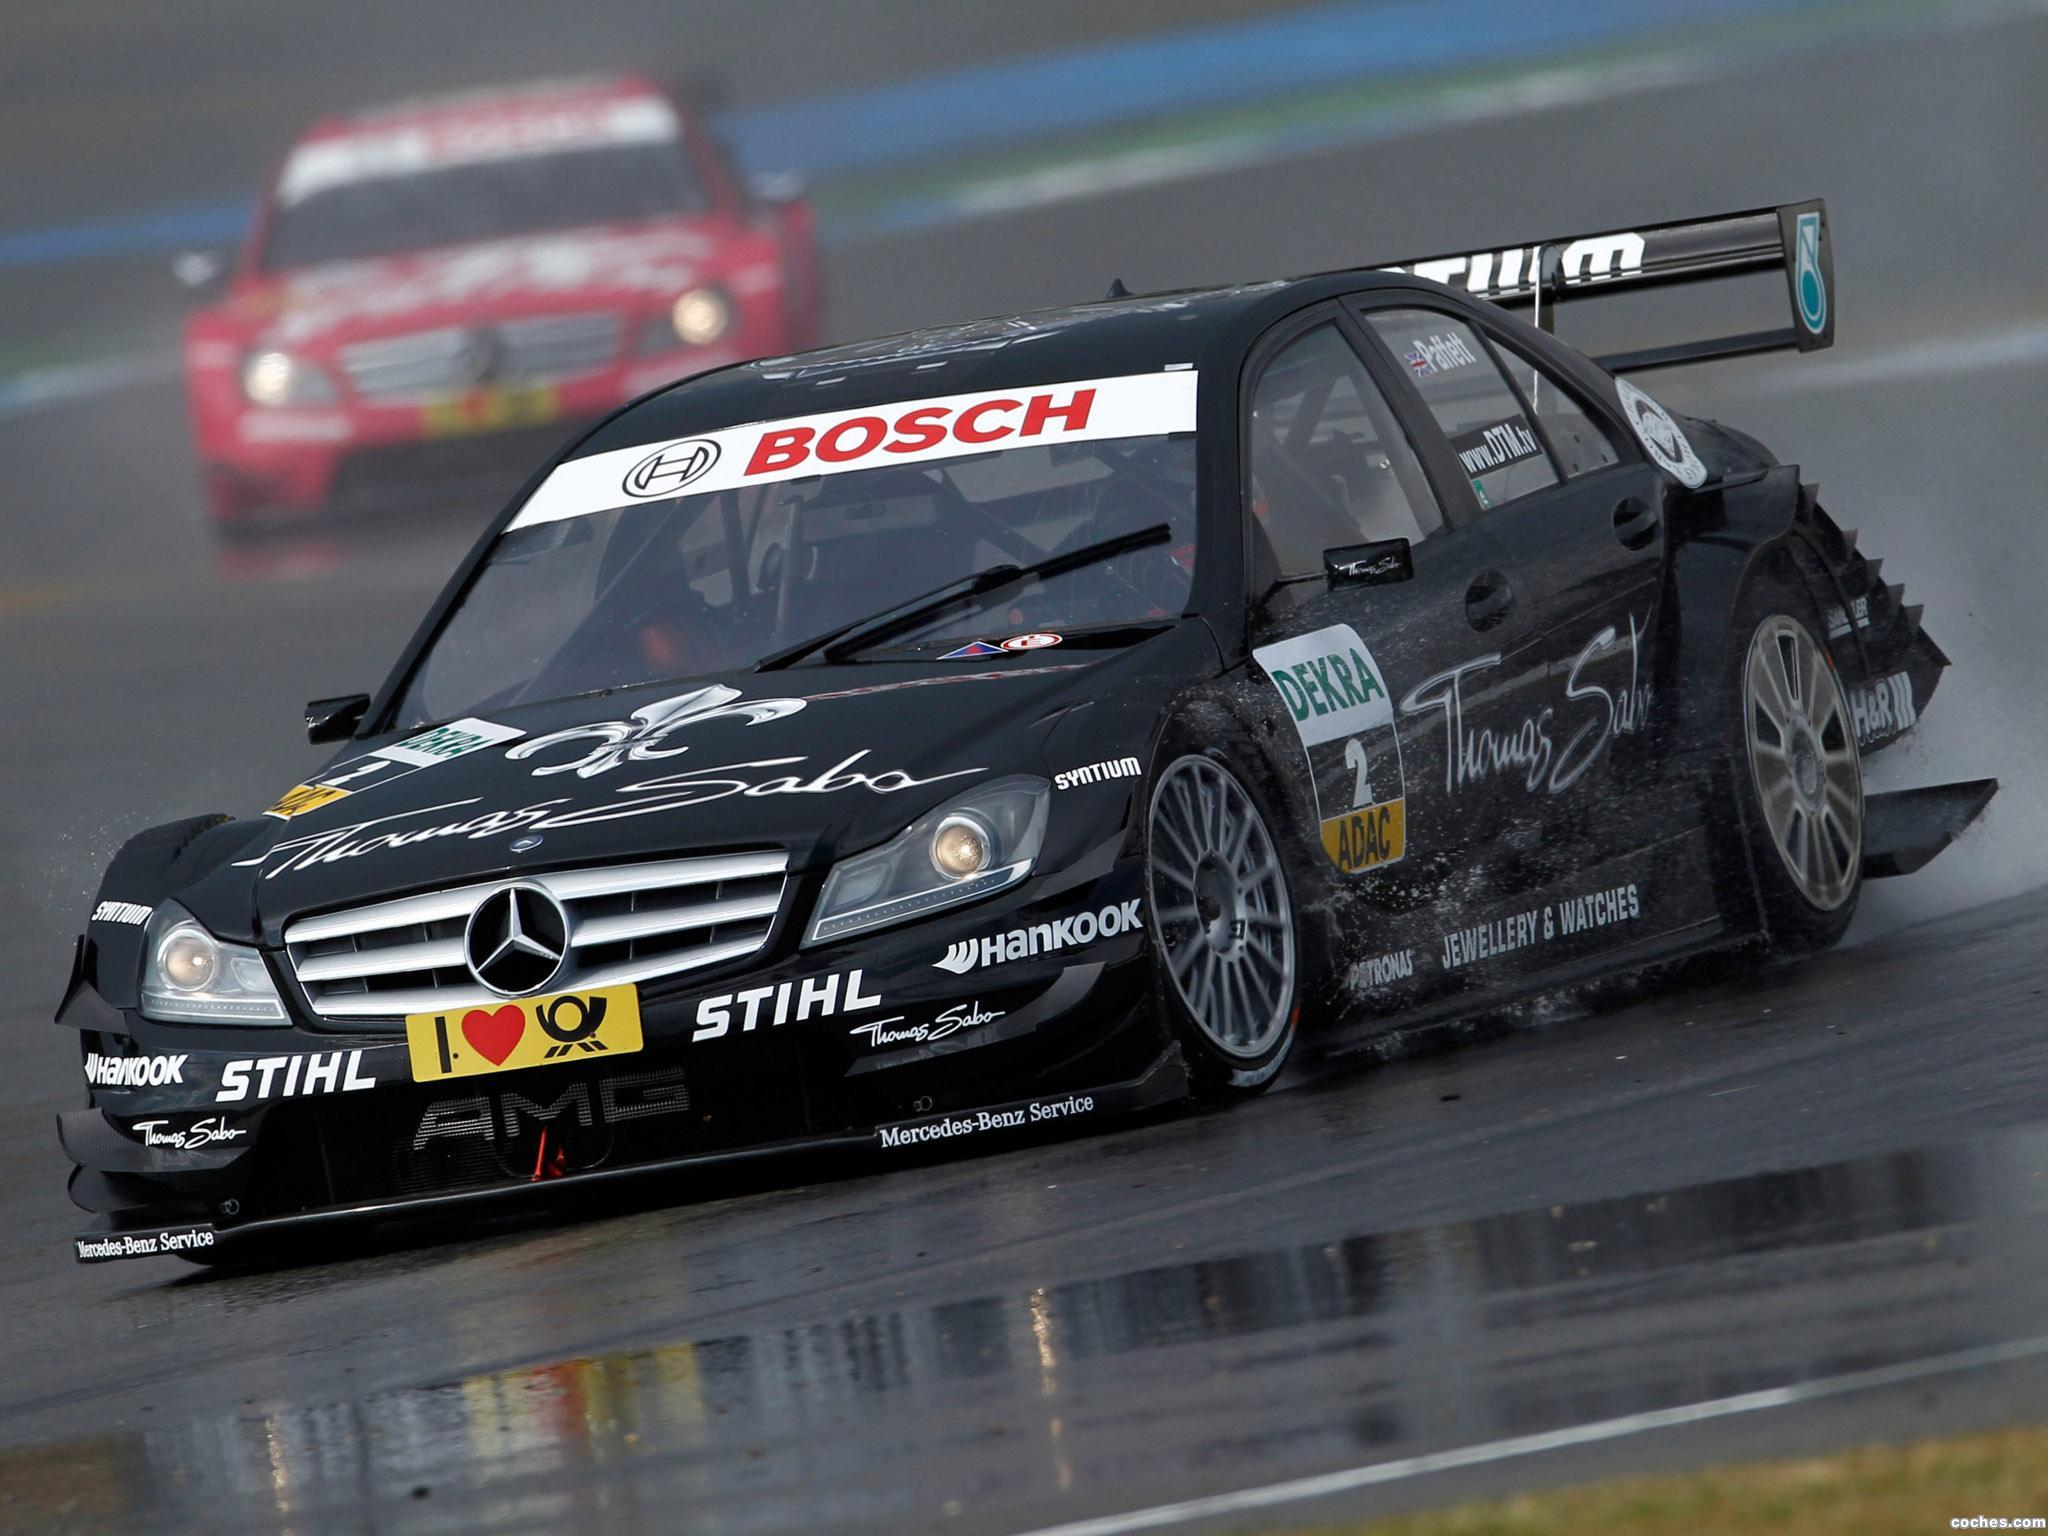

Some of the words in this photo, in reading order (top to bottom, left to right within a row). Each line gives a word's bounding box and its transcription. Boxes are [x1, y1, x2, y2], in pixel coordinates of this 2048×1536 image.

[743, 388, 1096, 476] BOSCH
[1458, 423, 1538, 474] www.DTM.tv
[1270, 648, 1386, 722] DEKRA
[1850, 681, 1894, 738] H&R
[395, 727, 496, 758] DEKRA
[1399, 654, 1554, 797] Thomas
[1054, 755, 1142, 791] SYNTIUM
[1345, 737, 1374, 808] 2
[231, 796, 573, 880] Thomas
[529, 750, 990, 830] Sabo
[1337, 806, 1392, 870] ADAC
[91, 900, 153, 926] SYNTIUM
[1442, 910, 1539, 970] JEWELLERY
[1543, 906, 1554, 941] &
[1559, 883, 1640, 936] WATCHES
[693, 969, 882, 1043] STIHL
[849, 1015, 930, 1048] Thomas
[927, 1000, 1006, 1042] Sabo
[435, 1015, 453, 1075] I
[215, 1049, 377, 1102] STIHL
[132, 1119, 186, 1149] Thomas
[183, 1116, 247, 1150] Sabo
[413, 1065, 690, 1151] AMG
[880, 1109, 1025, 1149] Mercedes-Benz
[1029, 1094, 1095, 1123] Service
[77, 1235, 158, 1258] Mercedes-Benz
[160, 1228, 215, 1250] Service
